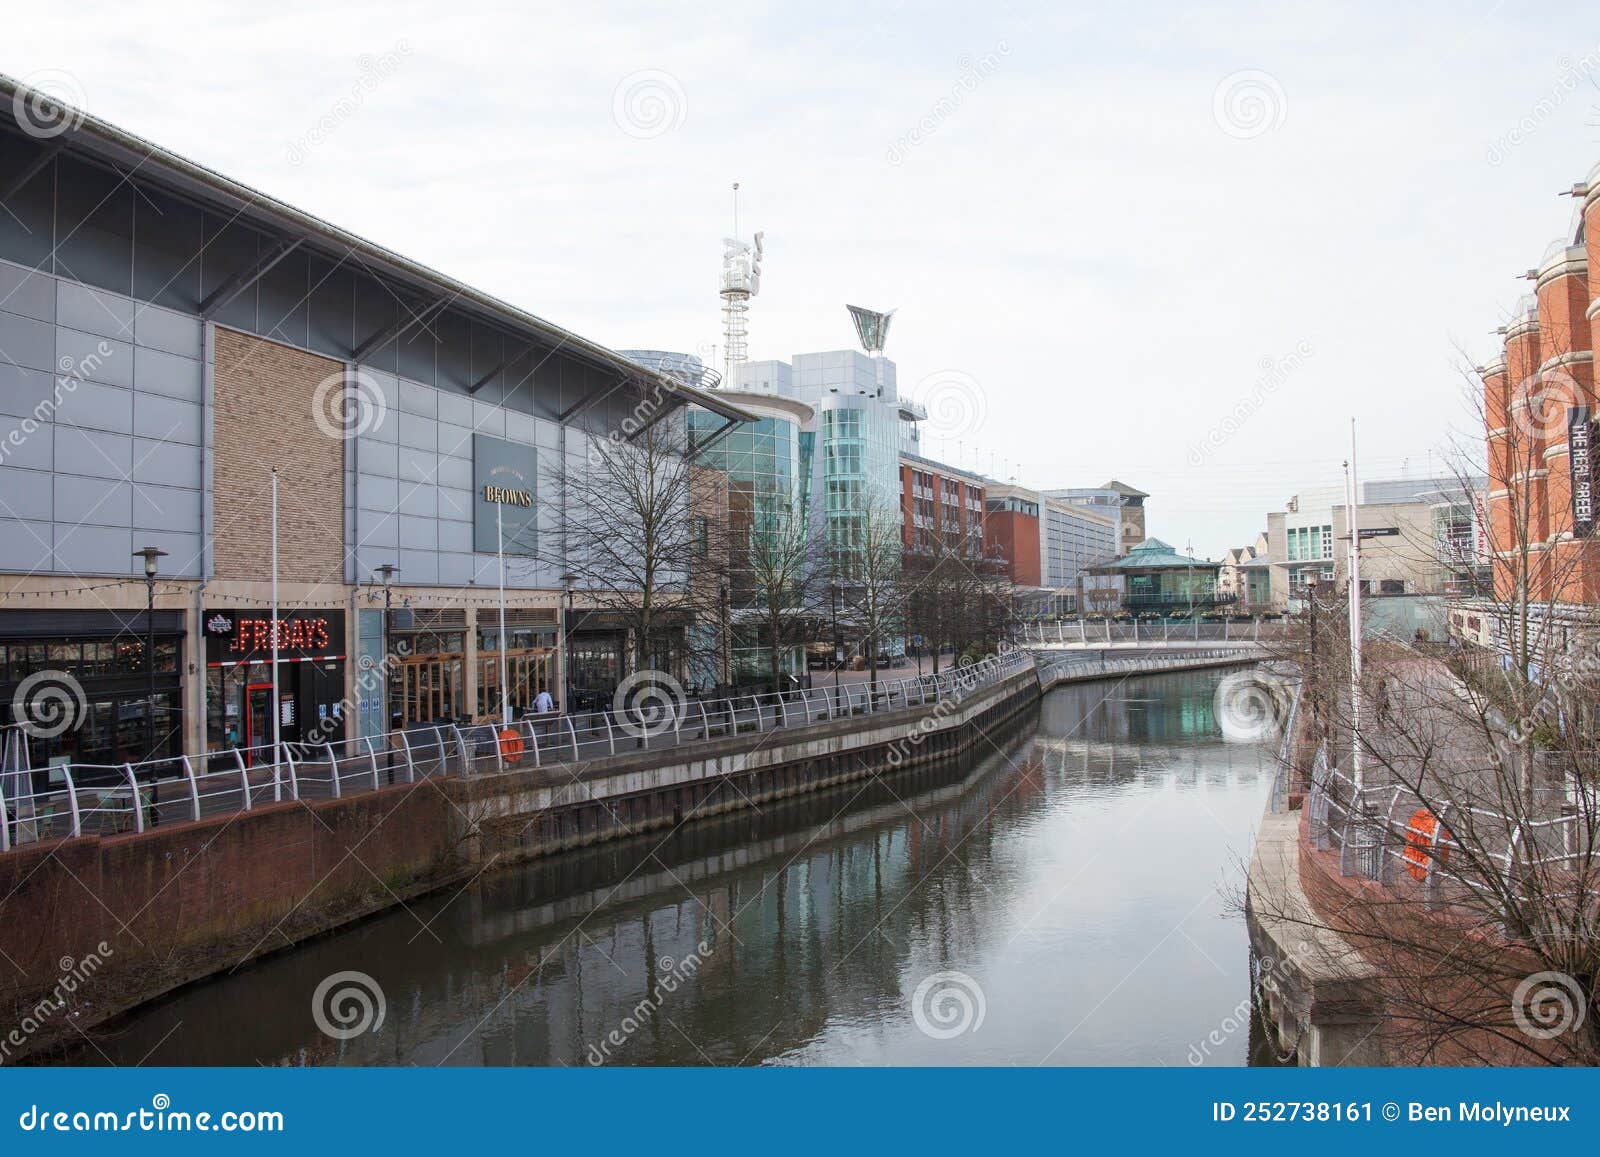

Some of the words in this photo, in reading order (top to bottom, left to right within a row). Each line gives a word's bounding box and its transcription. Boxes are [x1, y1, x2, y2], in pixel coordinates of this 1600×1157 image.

[1572, 422, 1588, 447] THE
[1573, 448, 1590, 481] REAL
[239, 617, 329, 652] FRIDAYS
